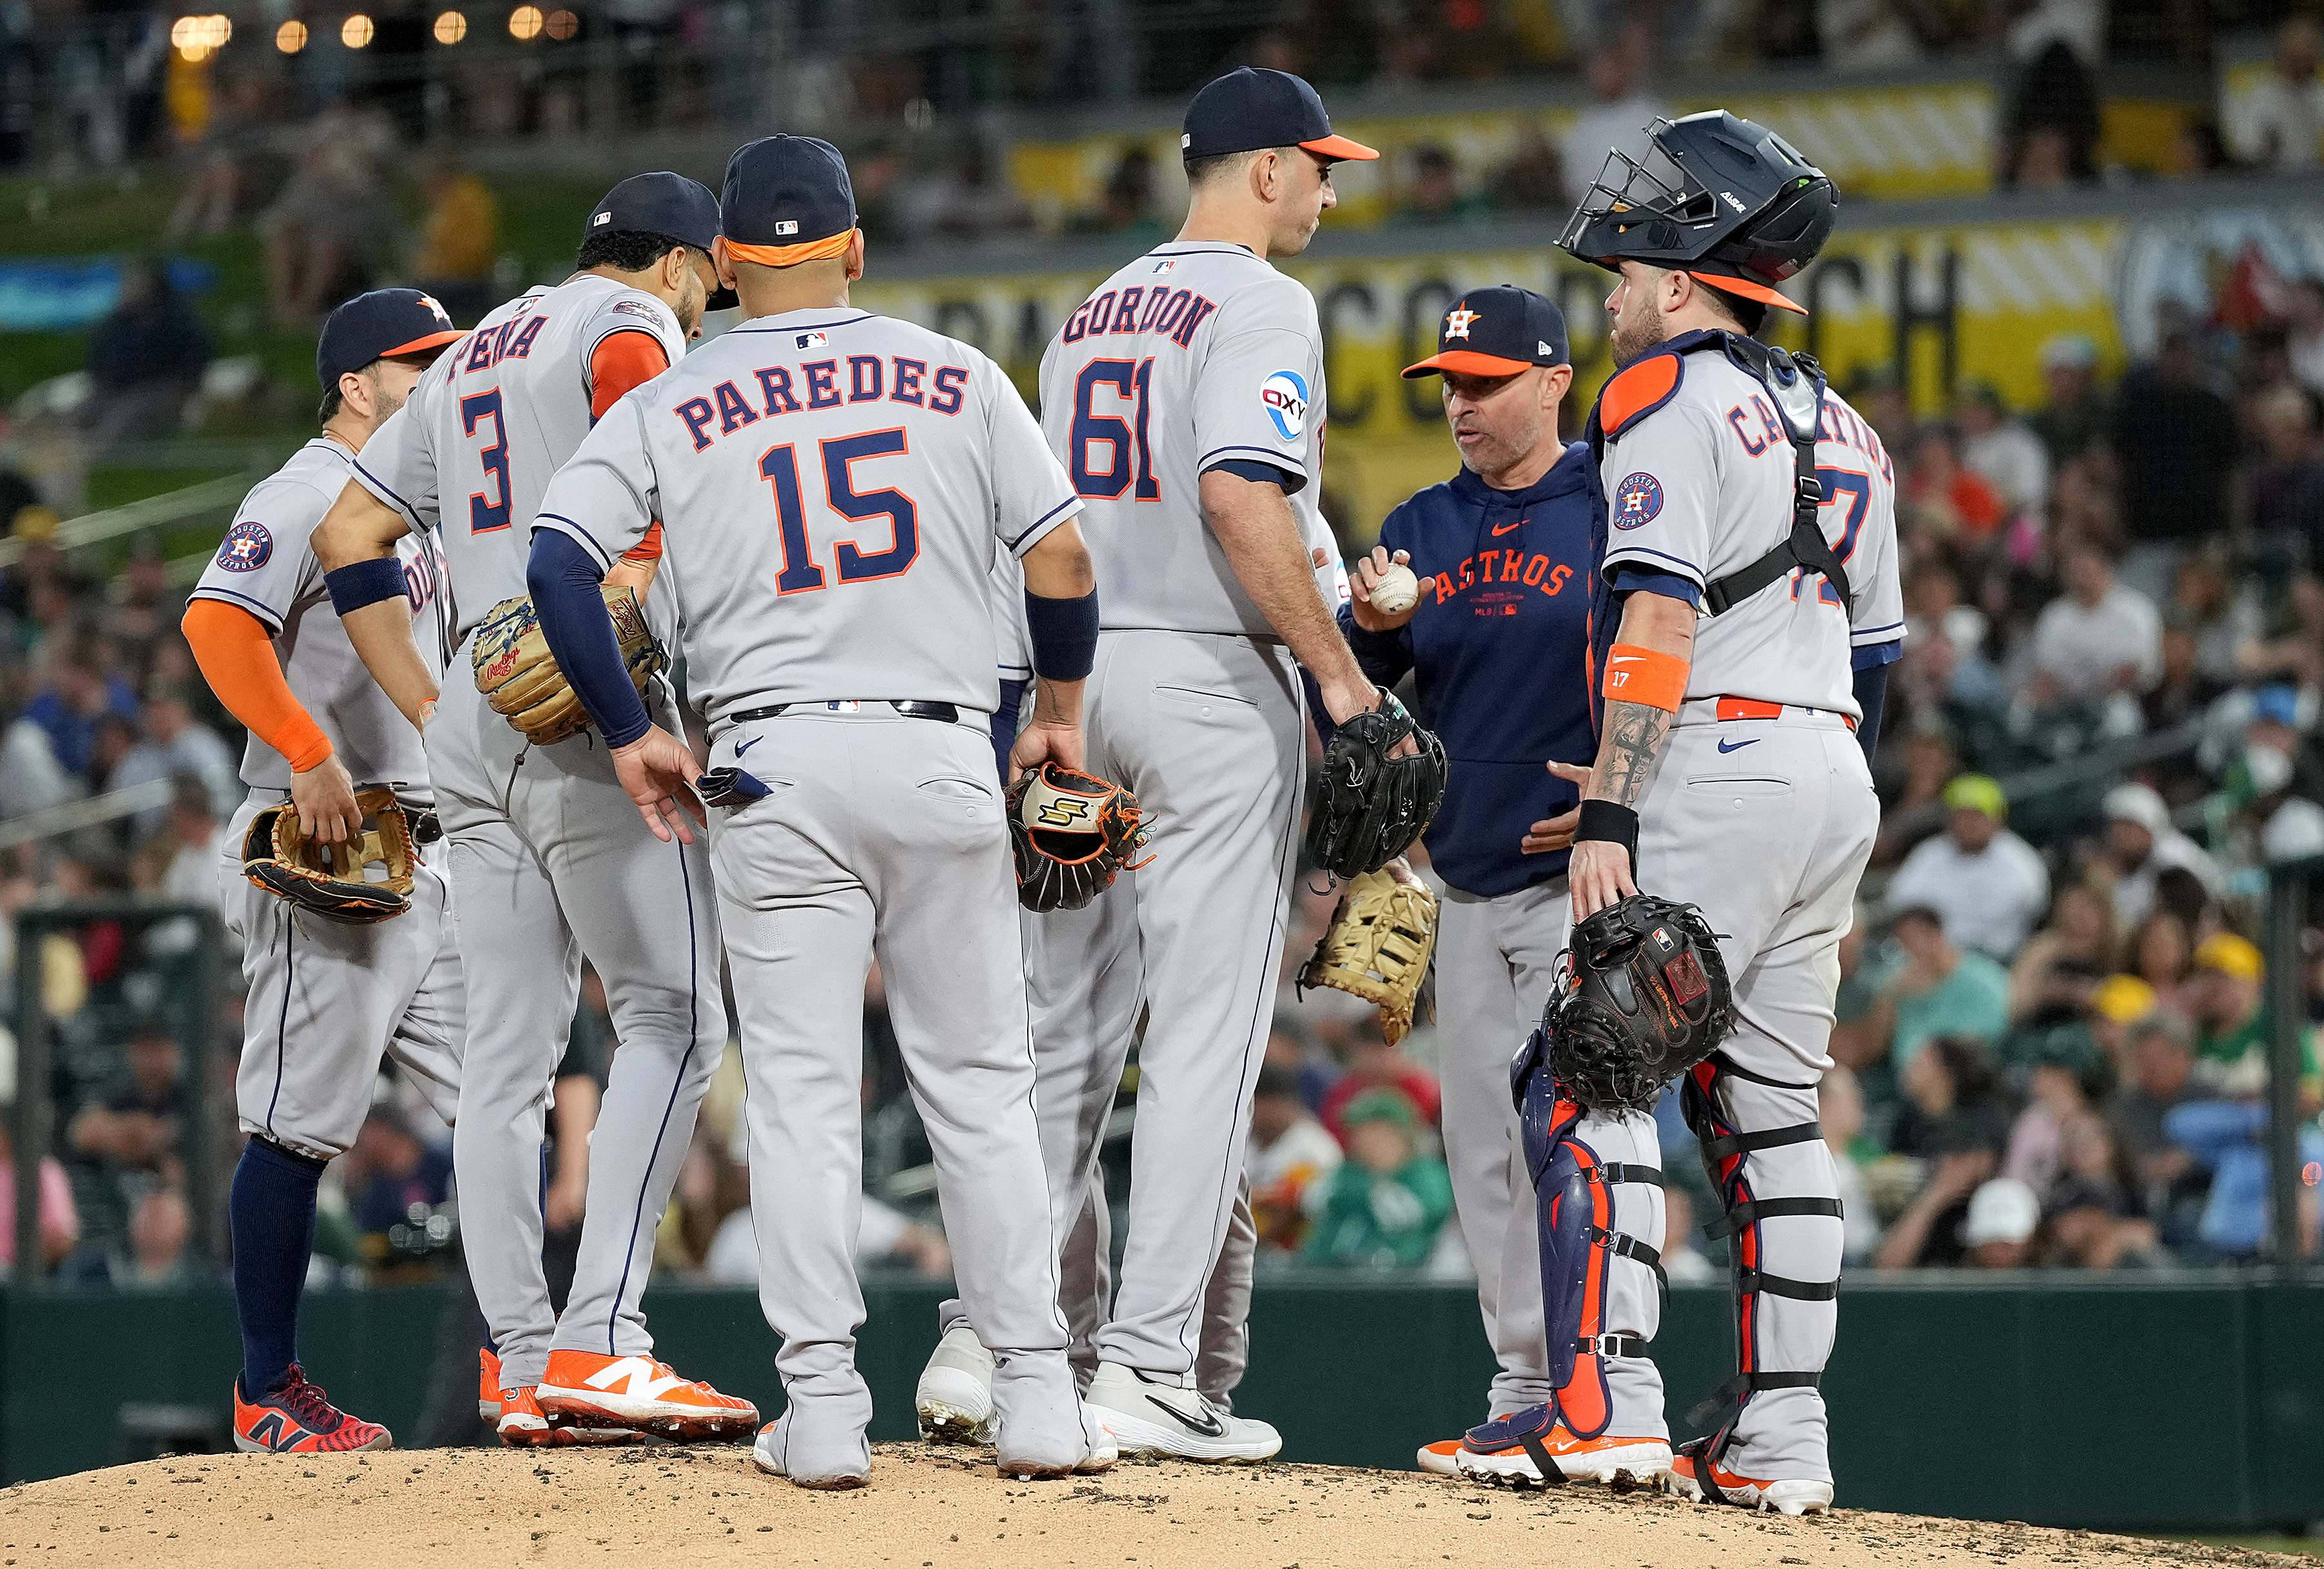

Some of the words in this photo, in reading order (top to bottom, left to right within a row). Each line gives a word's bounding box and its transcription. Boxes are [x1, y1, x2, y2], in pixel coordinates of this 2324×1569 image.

[1063, 285, 1218, 350] GORDON
[1445, 310, 1474, 338] H
[673, 354, 970, 453] PAREDES
[1263, 389, 1305, 420] OXY
[1069, 356, 1161, 502] 61
[460, 385, 513, 536] 3
[1619, 476, 1656, 495] HOUSTON
[758, 426, 920, 597] 15
[1616, 512, 1650, 526] ASTROS
[230, 525, 268, 542] HOUSTON
[219, 555, 254, 569] ASTROS
[1435, 549, 1574, 605] ASTROS
[1612, 671, 1630, 688] 17
